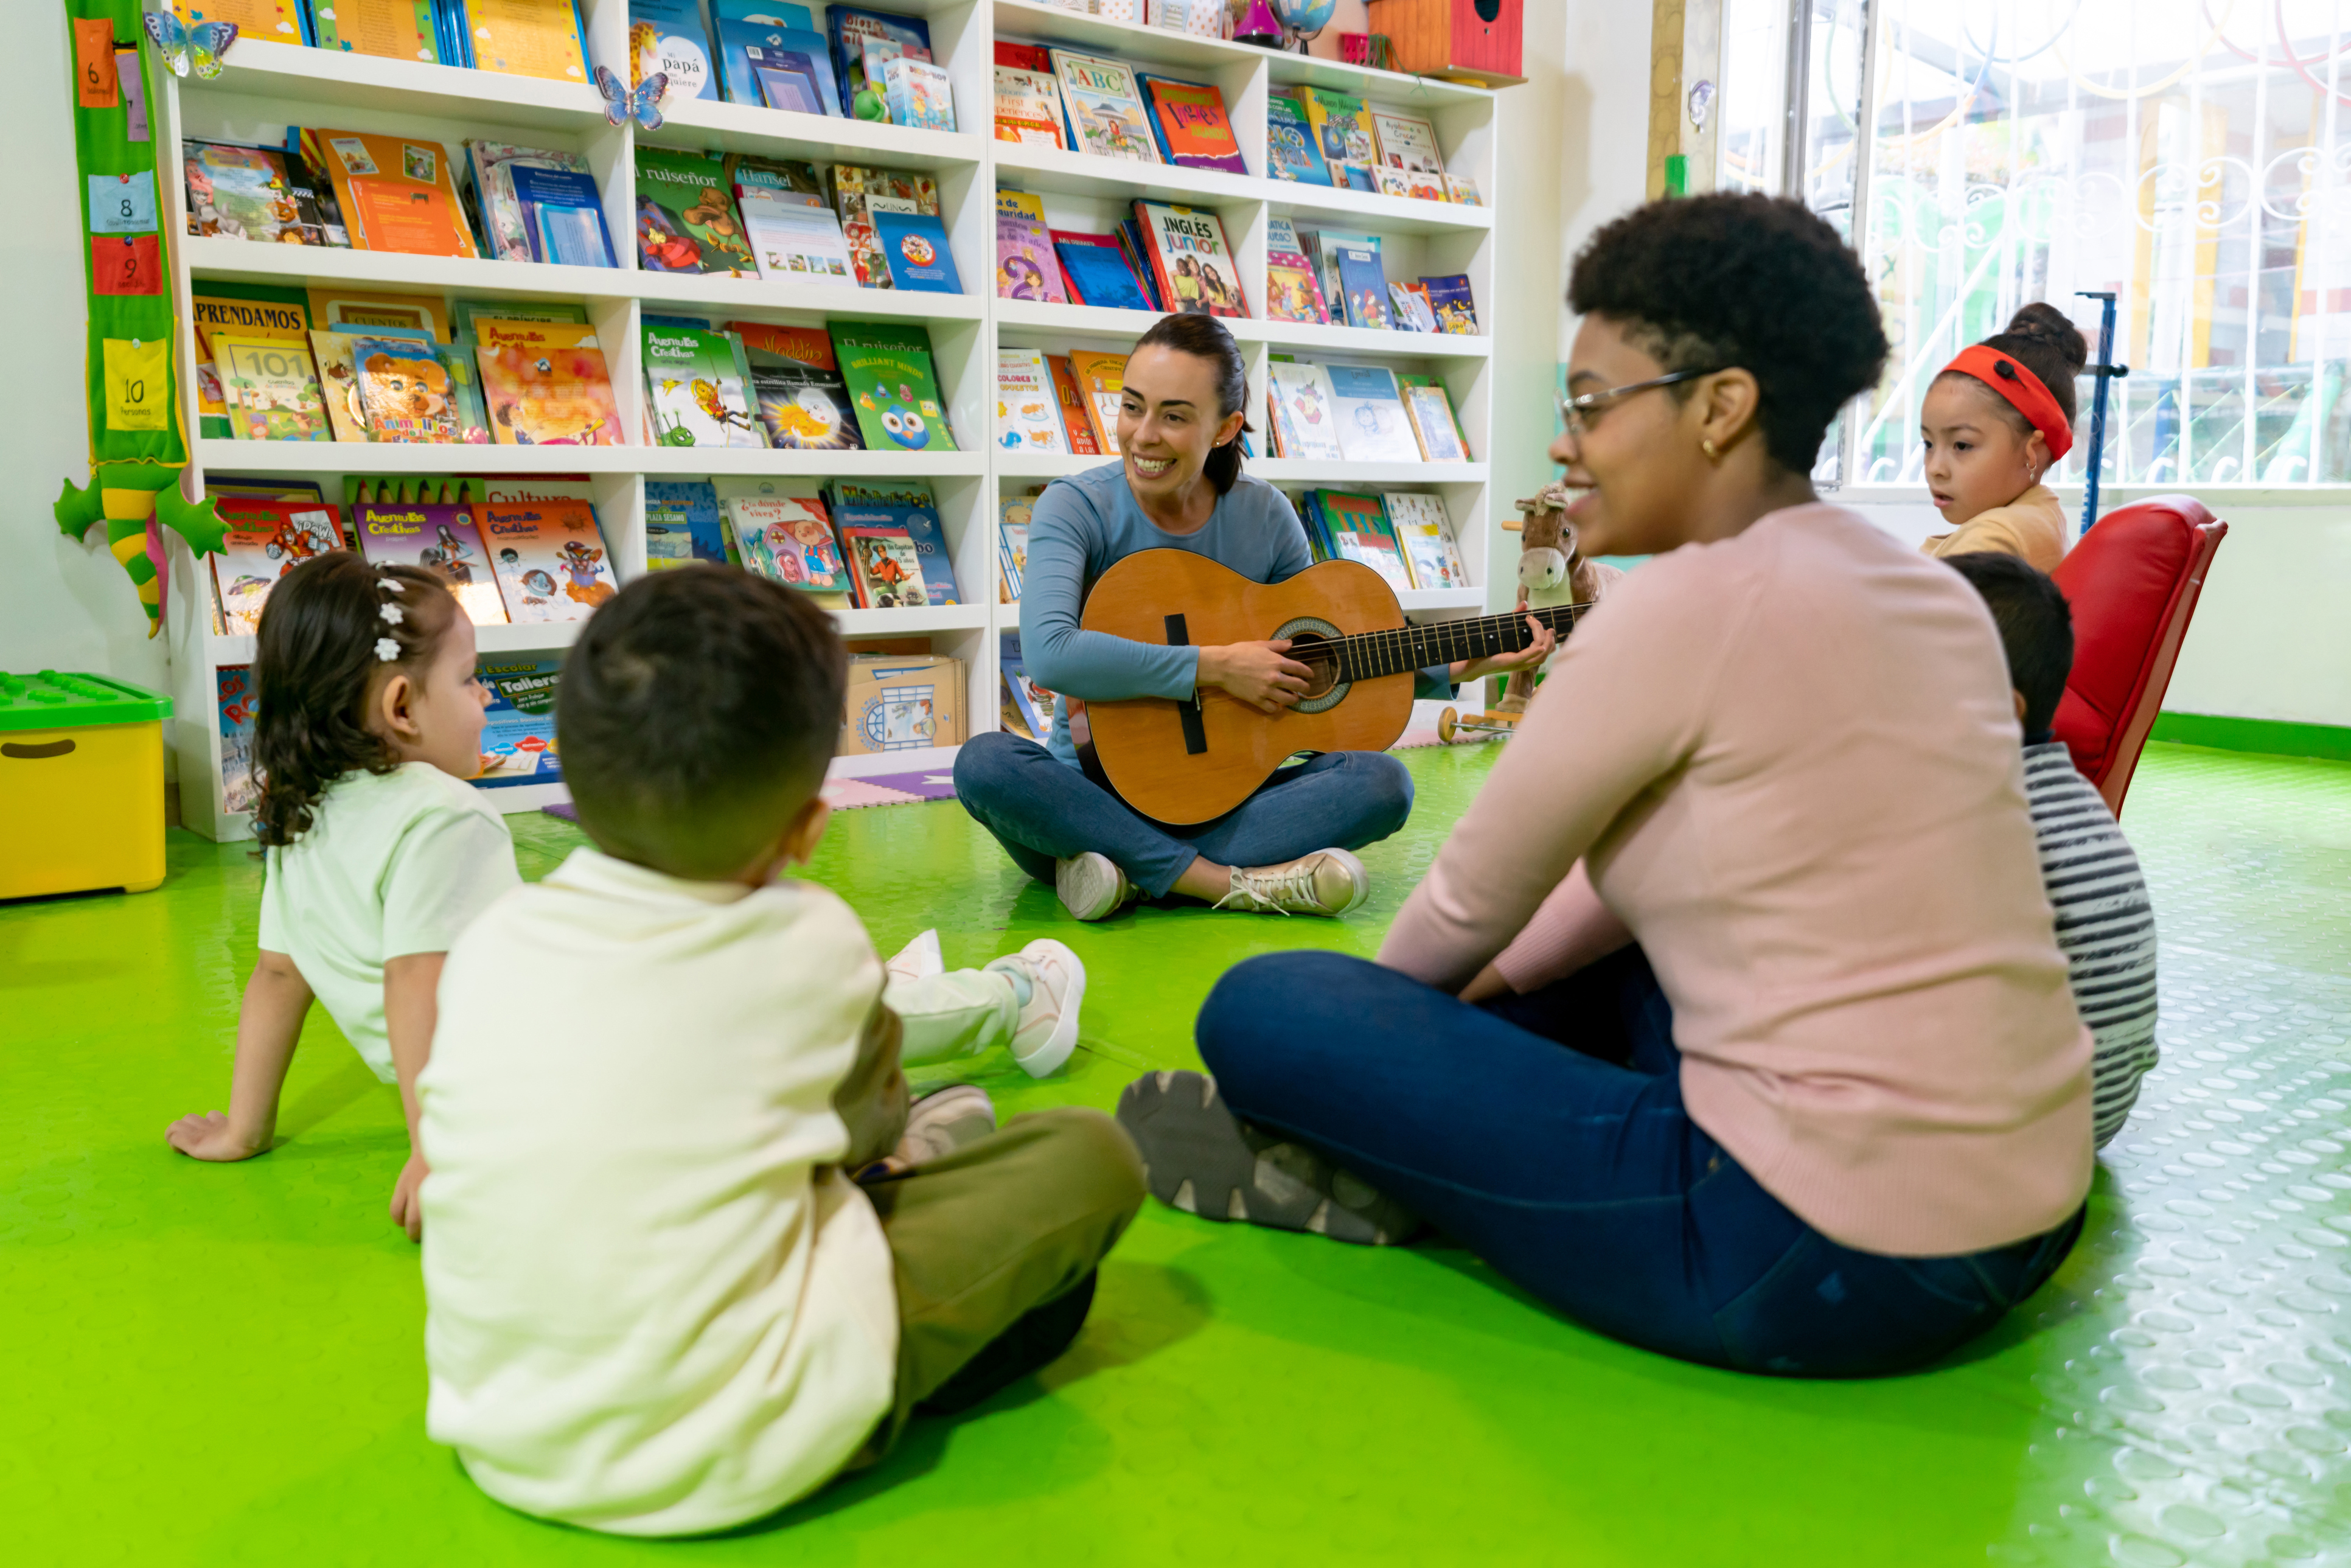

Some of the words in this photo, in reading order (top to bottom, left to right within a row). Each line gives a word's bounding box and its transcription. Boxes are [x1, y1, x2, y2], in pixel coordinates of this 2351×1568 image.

[846, 13, 871, 29] Dios
[88, 62, 99, 84] 6
[661, 58, 700, 74] papá
[668, 78, 697, 88] quiere
[1078, 68, 1121, 91] ABC
[994, 86, 1029, 98] Usborne
[1001, 95, 1025, 107] First
[994, 106, 1043, 119] periences
[1165, 103, 1219, 129] Inglés
[646, 169, 717, 187] ruiseñor
[742, 169, 792, 187] Hansel
[120, 199, 133, 217] 8
[886, 202, 899, 212] UN
[1006, 198, 1018, 208] de
[997, 209, 1036, 221] guridad
[1000, 220, 1028, 230] uentos
[1163, 217, 1213, 239] INGLÉS
[1028, 238, 1048, 252] años
[1163, 228, 1219, 255] junior
[125, 259, 137, 278] 9
[1401, 301, 1412, 322] SPACE
[355, 316, 406, 327] CUENTOS
[489, 326, 545, 341] Aventuras
[648, 332, 699, 347] Aventuras
[650, 346, 695, 358] Creativas
[762, 335, 823, 361] Aladdin
[862, 341, 923, 352] ruiseñor
[245, 352, 305, 378] 101
[851, 357, 894, 369] BRILLIANT
[896, 361, 924, 379] MINDS
[1088, 359, 1108, 371] PRIMERA
[787, 378, 810, 387] llamada
[125, 378, 144, 403] 10
[374, 417, 458, 437] Animalitos
[419, 428, 430, 437] la
[217, 506, 280, 521] Aventuras
[366, 509, 427, 523] Aventuras
[487, 510, 542, 523] Aventuras
[646, 513, 662, 521] PLAZA
[663, 513, 684, 522] SESAMO
[750, 508, 781, 520] vives?
[368, 523, 420, 534] Creativas
[489, 522, 538, 534] Creativas
[916, 540, 934, 553] bo
[486, 663, 537, 674] Escolar
[482, 678, 495, 689] de
[500, 675, 561, 693] Tallere
[860, 695, 880, 714] AZUL
[855, 717, 880, 753] VENTANA
